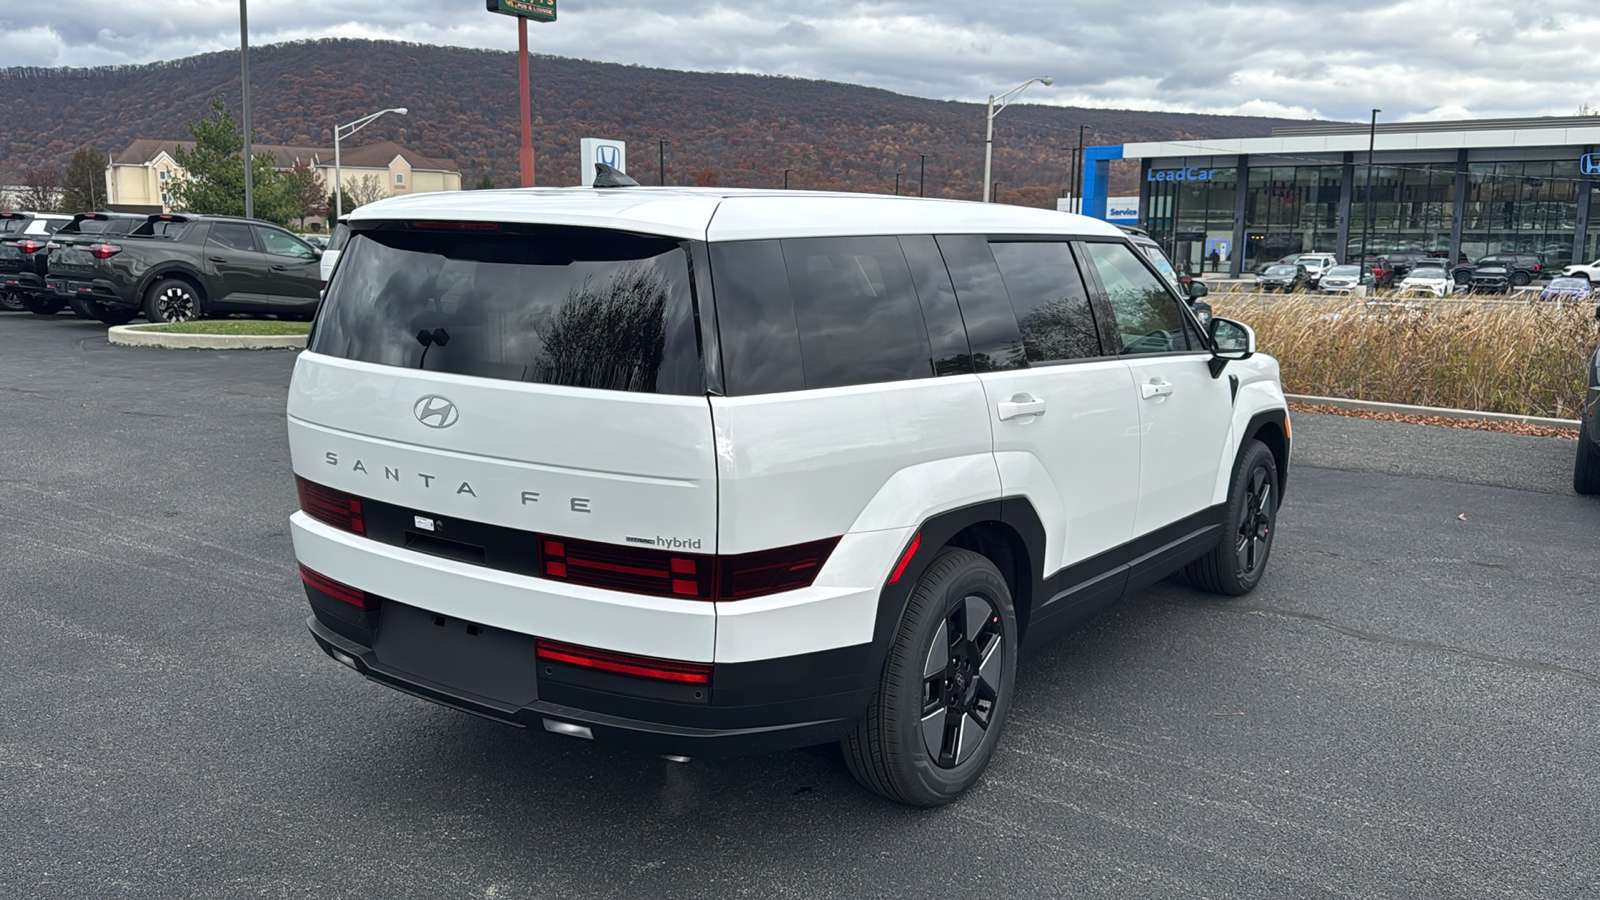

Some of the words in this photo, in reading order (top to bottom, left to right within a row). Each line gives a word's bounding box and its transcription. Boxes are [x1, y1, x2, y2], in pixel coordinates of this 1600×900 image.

[533, 7, 553, 15] LOUNGE
[1147, 166, 1215, 182] LeadCar
[1110, 207, 1138, 216] Service
[325, 451, 478, 498] SANTA
[521, 490, 592, 514] FE
[656, 534, 702, 550] hybrid
